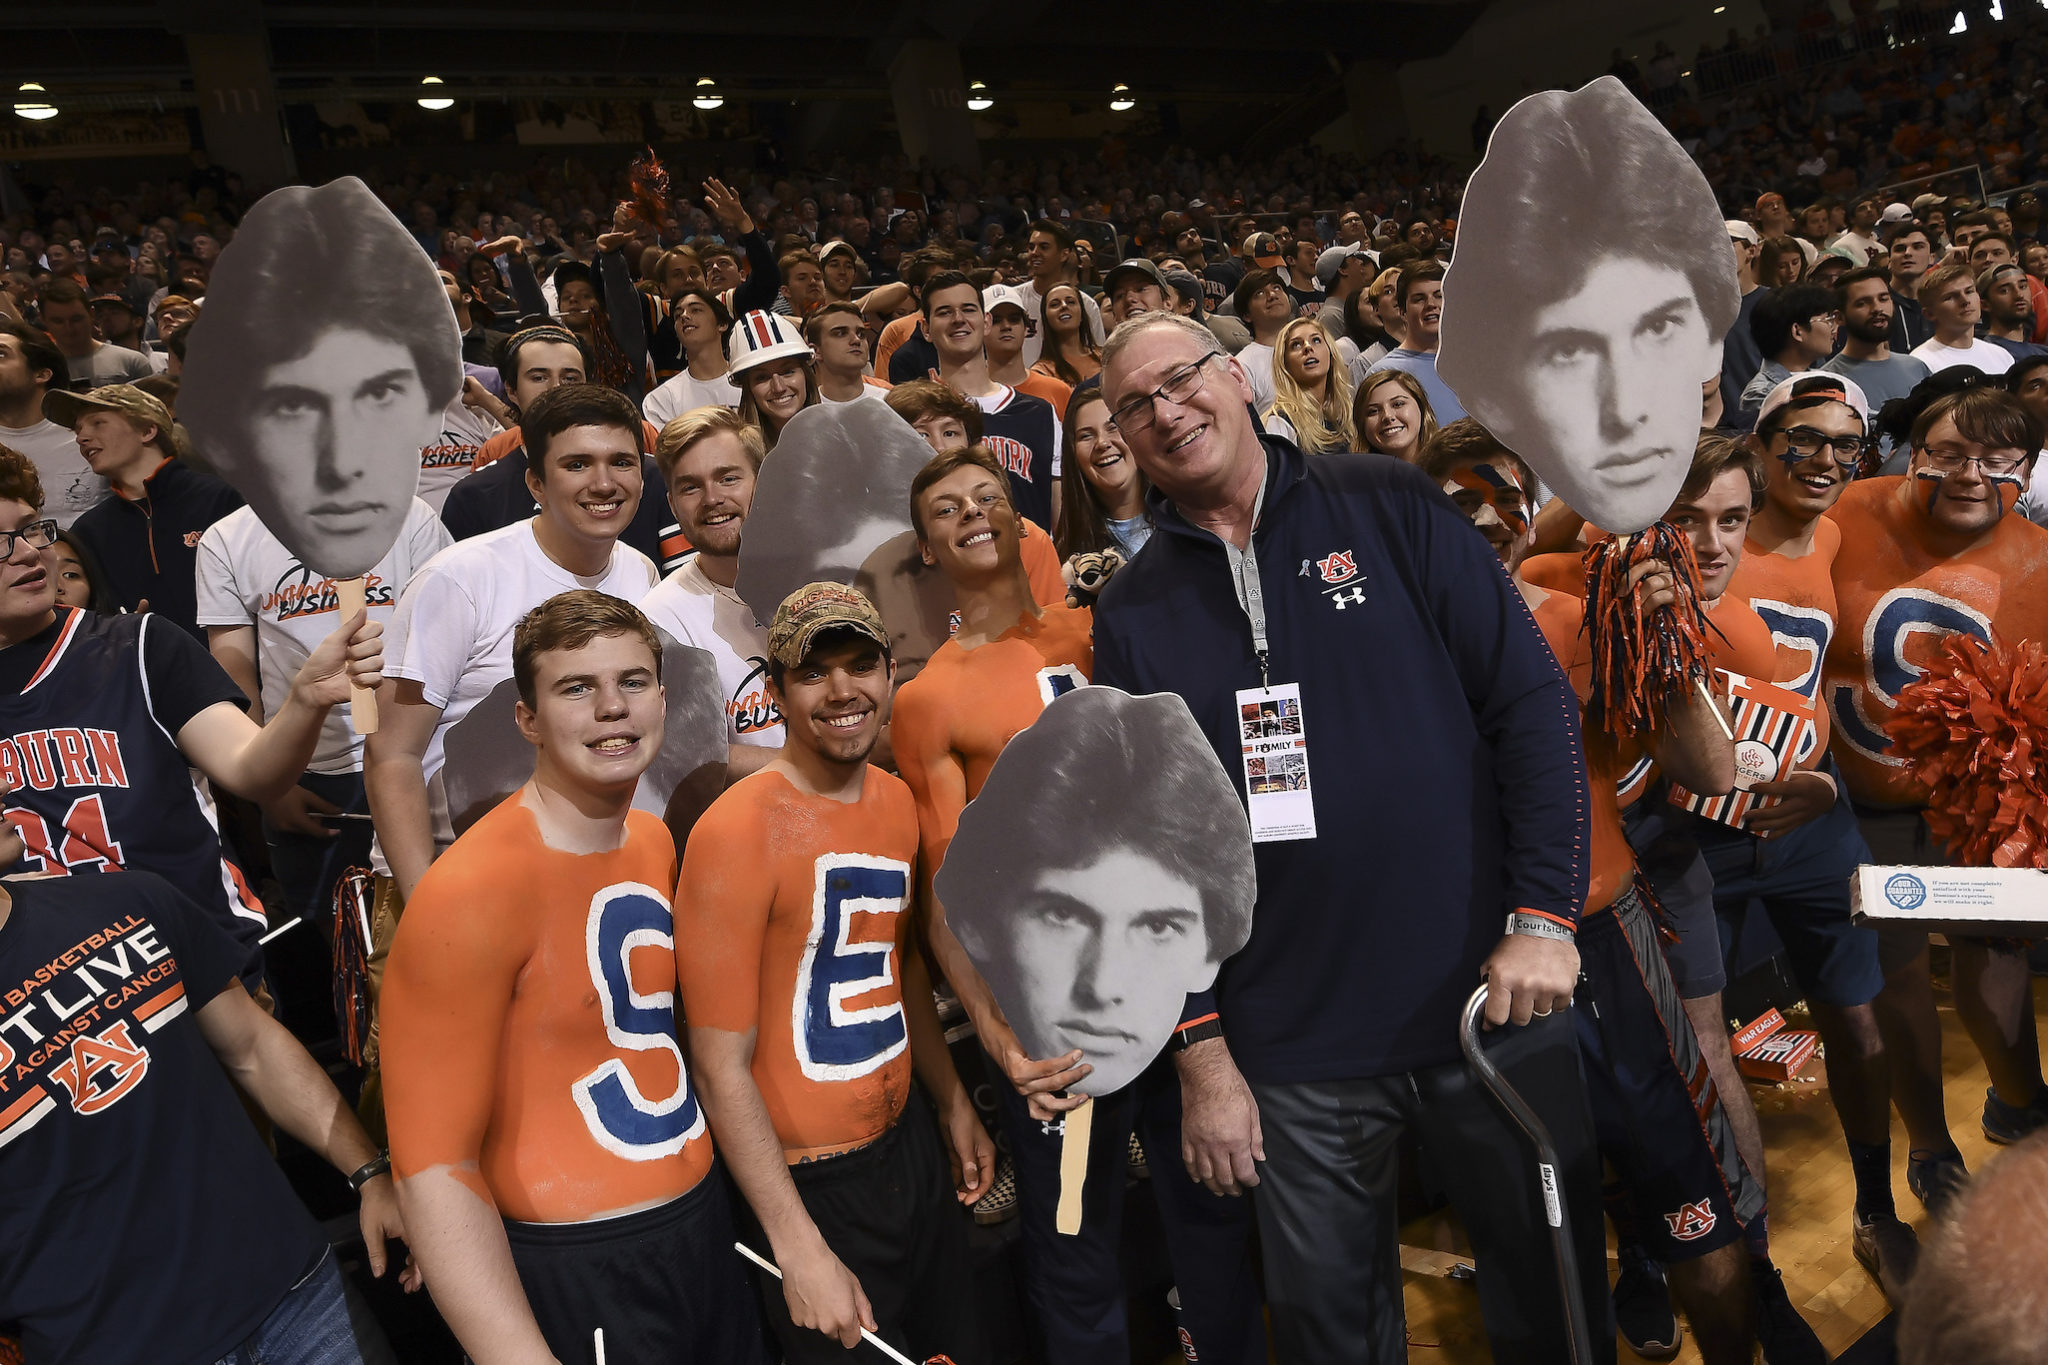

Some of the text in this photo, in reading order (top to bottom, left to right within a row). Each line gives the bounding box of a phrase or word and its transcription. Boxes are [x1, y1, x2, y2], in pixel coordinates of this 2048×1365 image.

[212, 88, 262, 113] 111
[277, 586, 392, 621] BUSINSS
[1516, 919, 1568, 936] Courtside
[3, 914, 147, 1007] BASKETBALL
[792, 852, 911, 1082] E
[15, 1004, 102, 1082] AGAINST
[103, 957, 178, 1010] CANCER
[572, 881, 705, 1162] S
[1738, 1028, 1758, 1045] WAR
